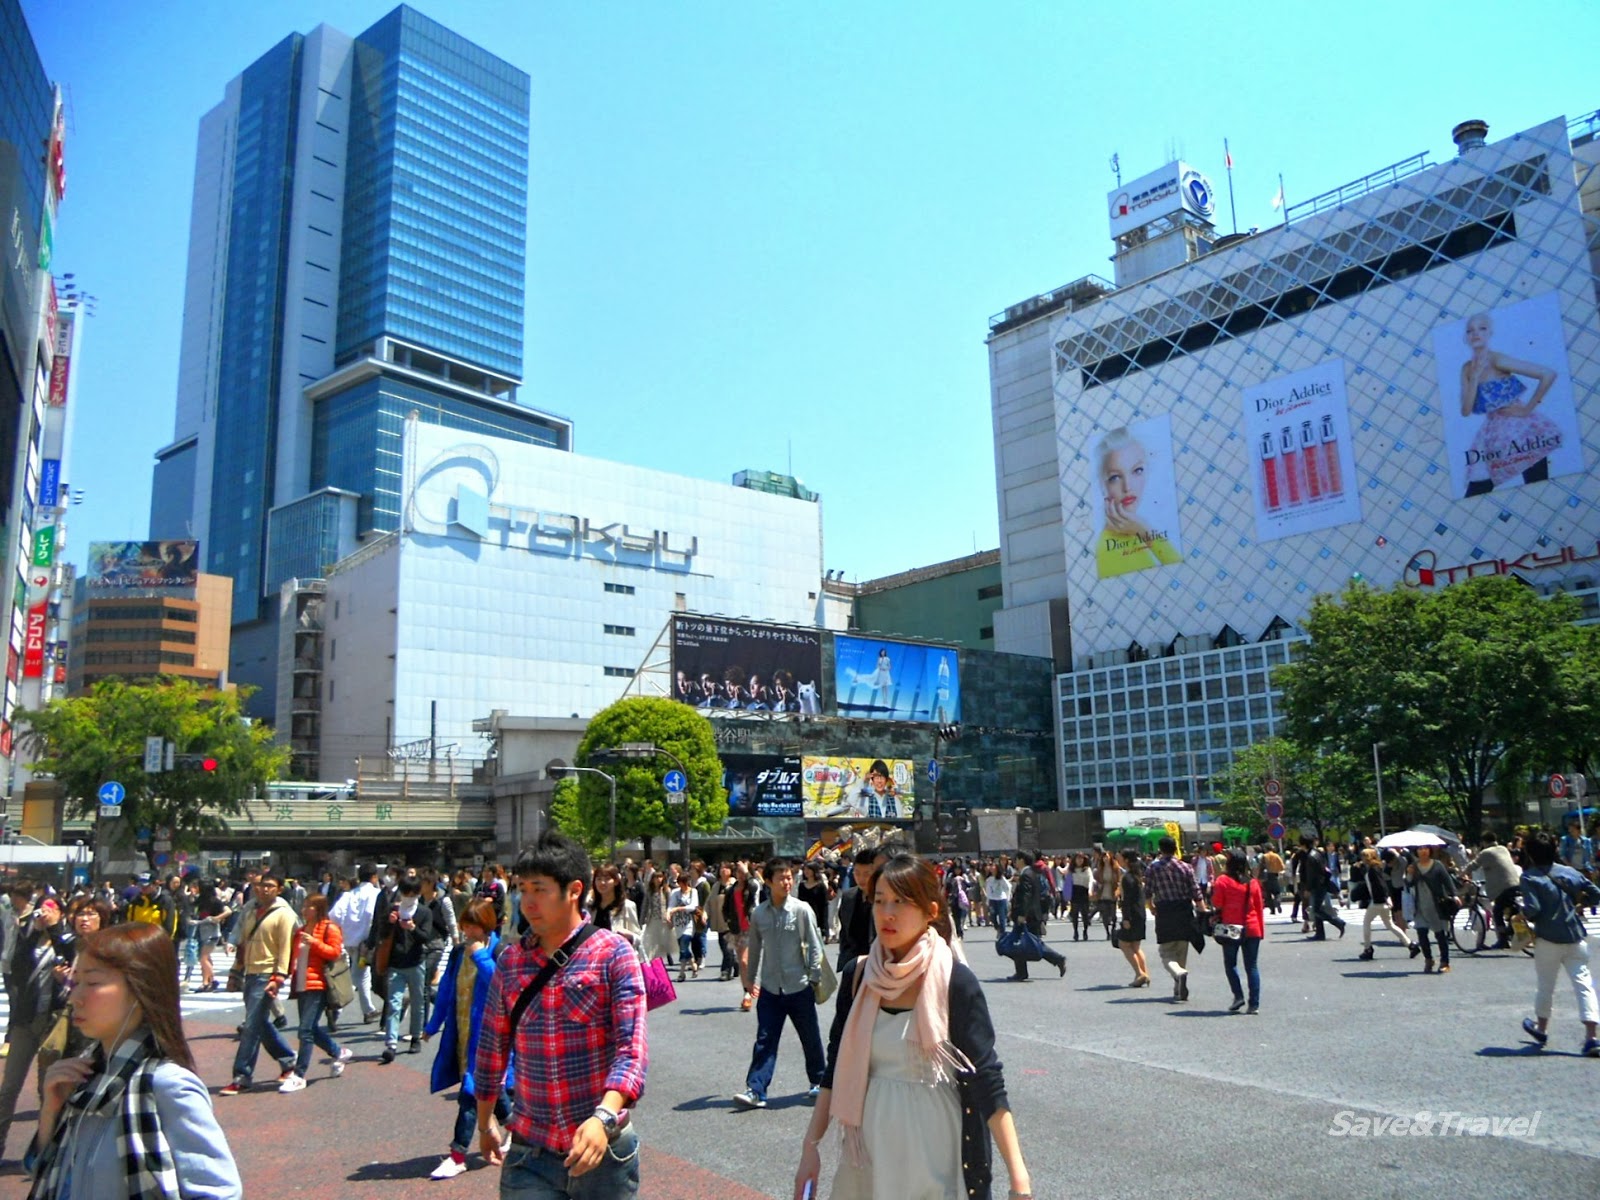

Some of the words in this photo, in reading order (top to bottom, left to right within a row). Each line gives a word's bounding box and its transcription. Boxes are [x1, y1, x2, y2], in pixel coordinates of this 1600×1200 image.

[1129, 186, 1179, 212] TOKYU
[1255, 395, 1285, 413] Dior
[1288, 382, 1331, 403] Addict
[1464, 449, 1502, 466] Dior
[1507, 434, 1561, 456] Addict
[488, 503, 698, 557] TOKYU
[1105, 538, 1129, 552] Dior
[1133, 530, 1168, 545] Addict
[38, 534, 49, 560] レイク
[1434, 541, 1600, 584] TOKYU
[28, 613, 45, 650] アコム
[757, 769, 800, 784] ダブルス
